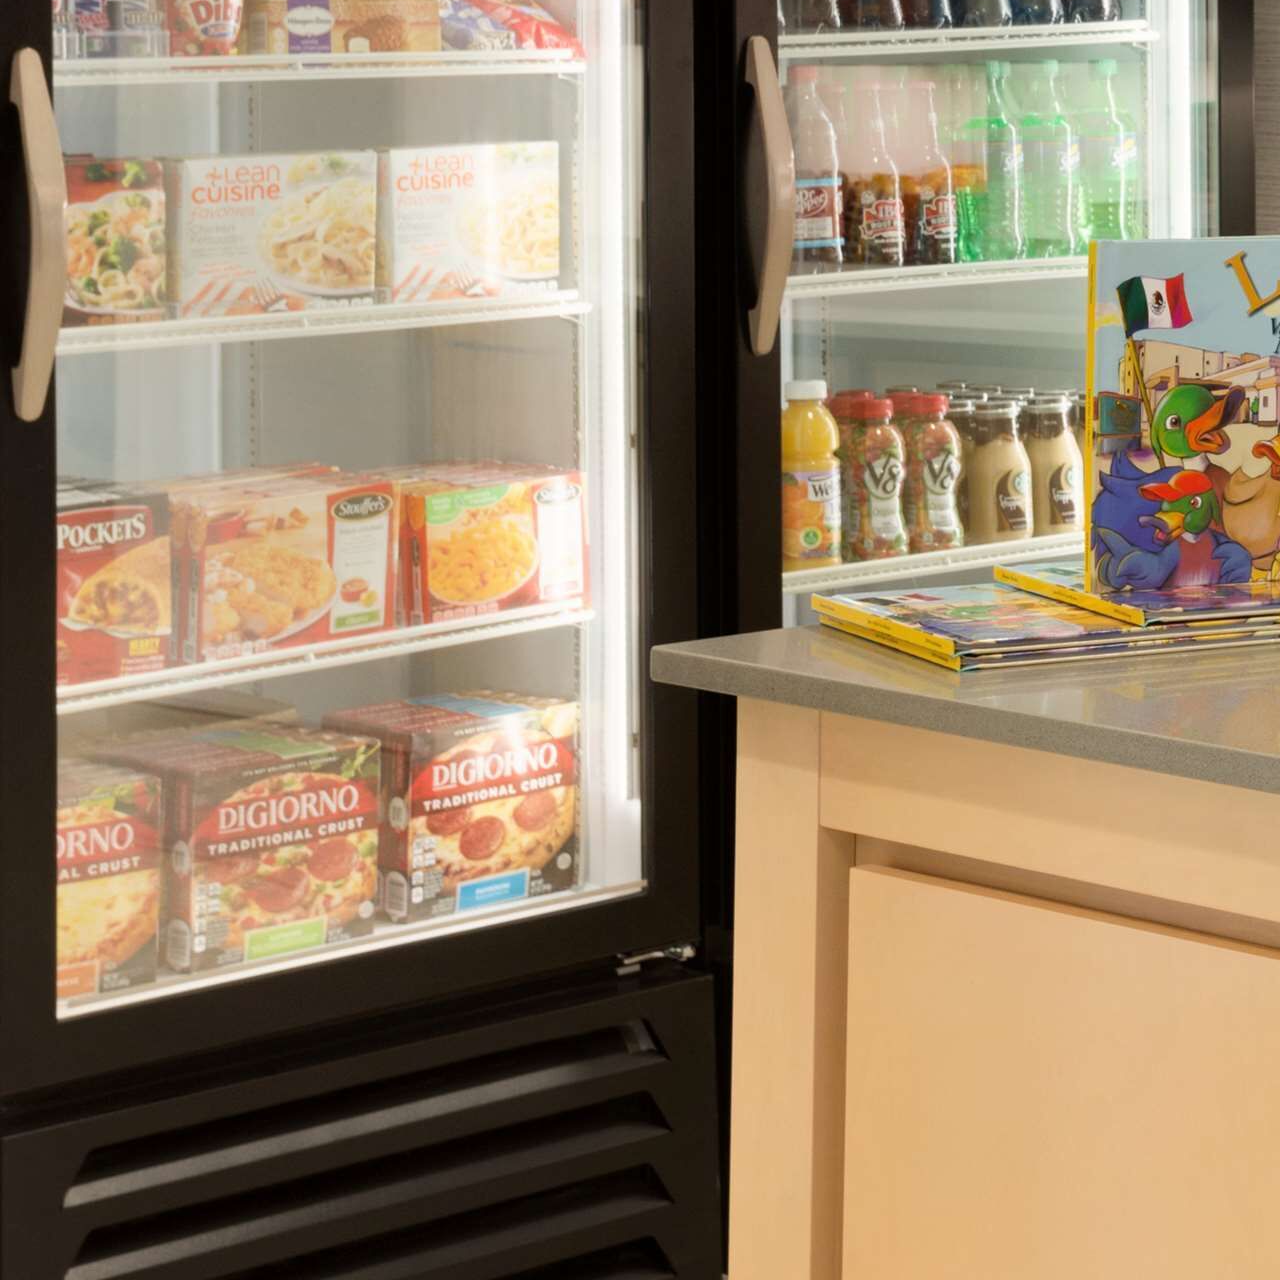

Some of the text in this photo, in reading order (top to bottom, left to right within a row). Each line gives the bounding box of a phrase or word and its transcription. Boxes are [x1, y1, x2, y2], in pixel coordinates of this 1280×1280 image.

[191, 182, 282, 205] cuisine
[866, 457, 899, 495] V8
[339, 496, 387, 517] Stouffer's
[58, 513, 147, 550] POCKETS
[432, 742, 560, 792] DIGIORNO
[218, 784, 361, 834] DIGIORNO
[423, 772, 563, 813] TRADITIONAL CRUST
[207, 816, 365, 856] TRADITIONAL CRUST
[87, 856, 141, 876] CRUST
